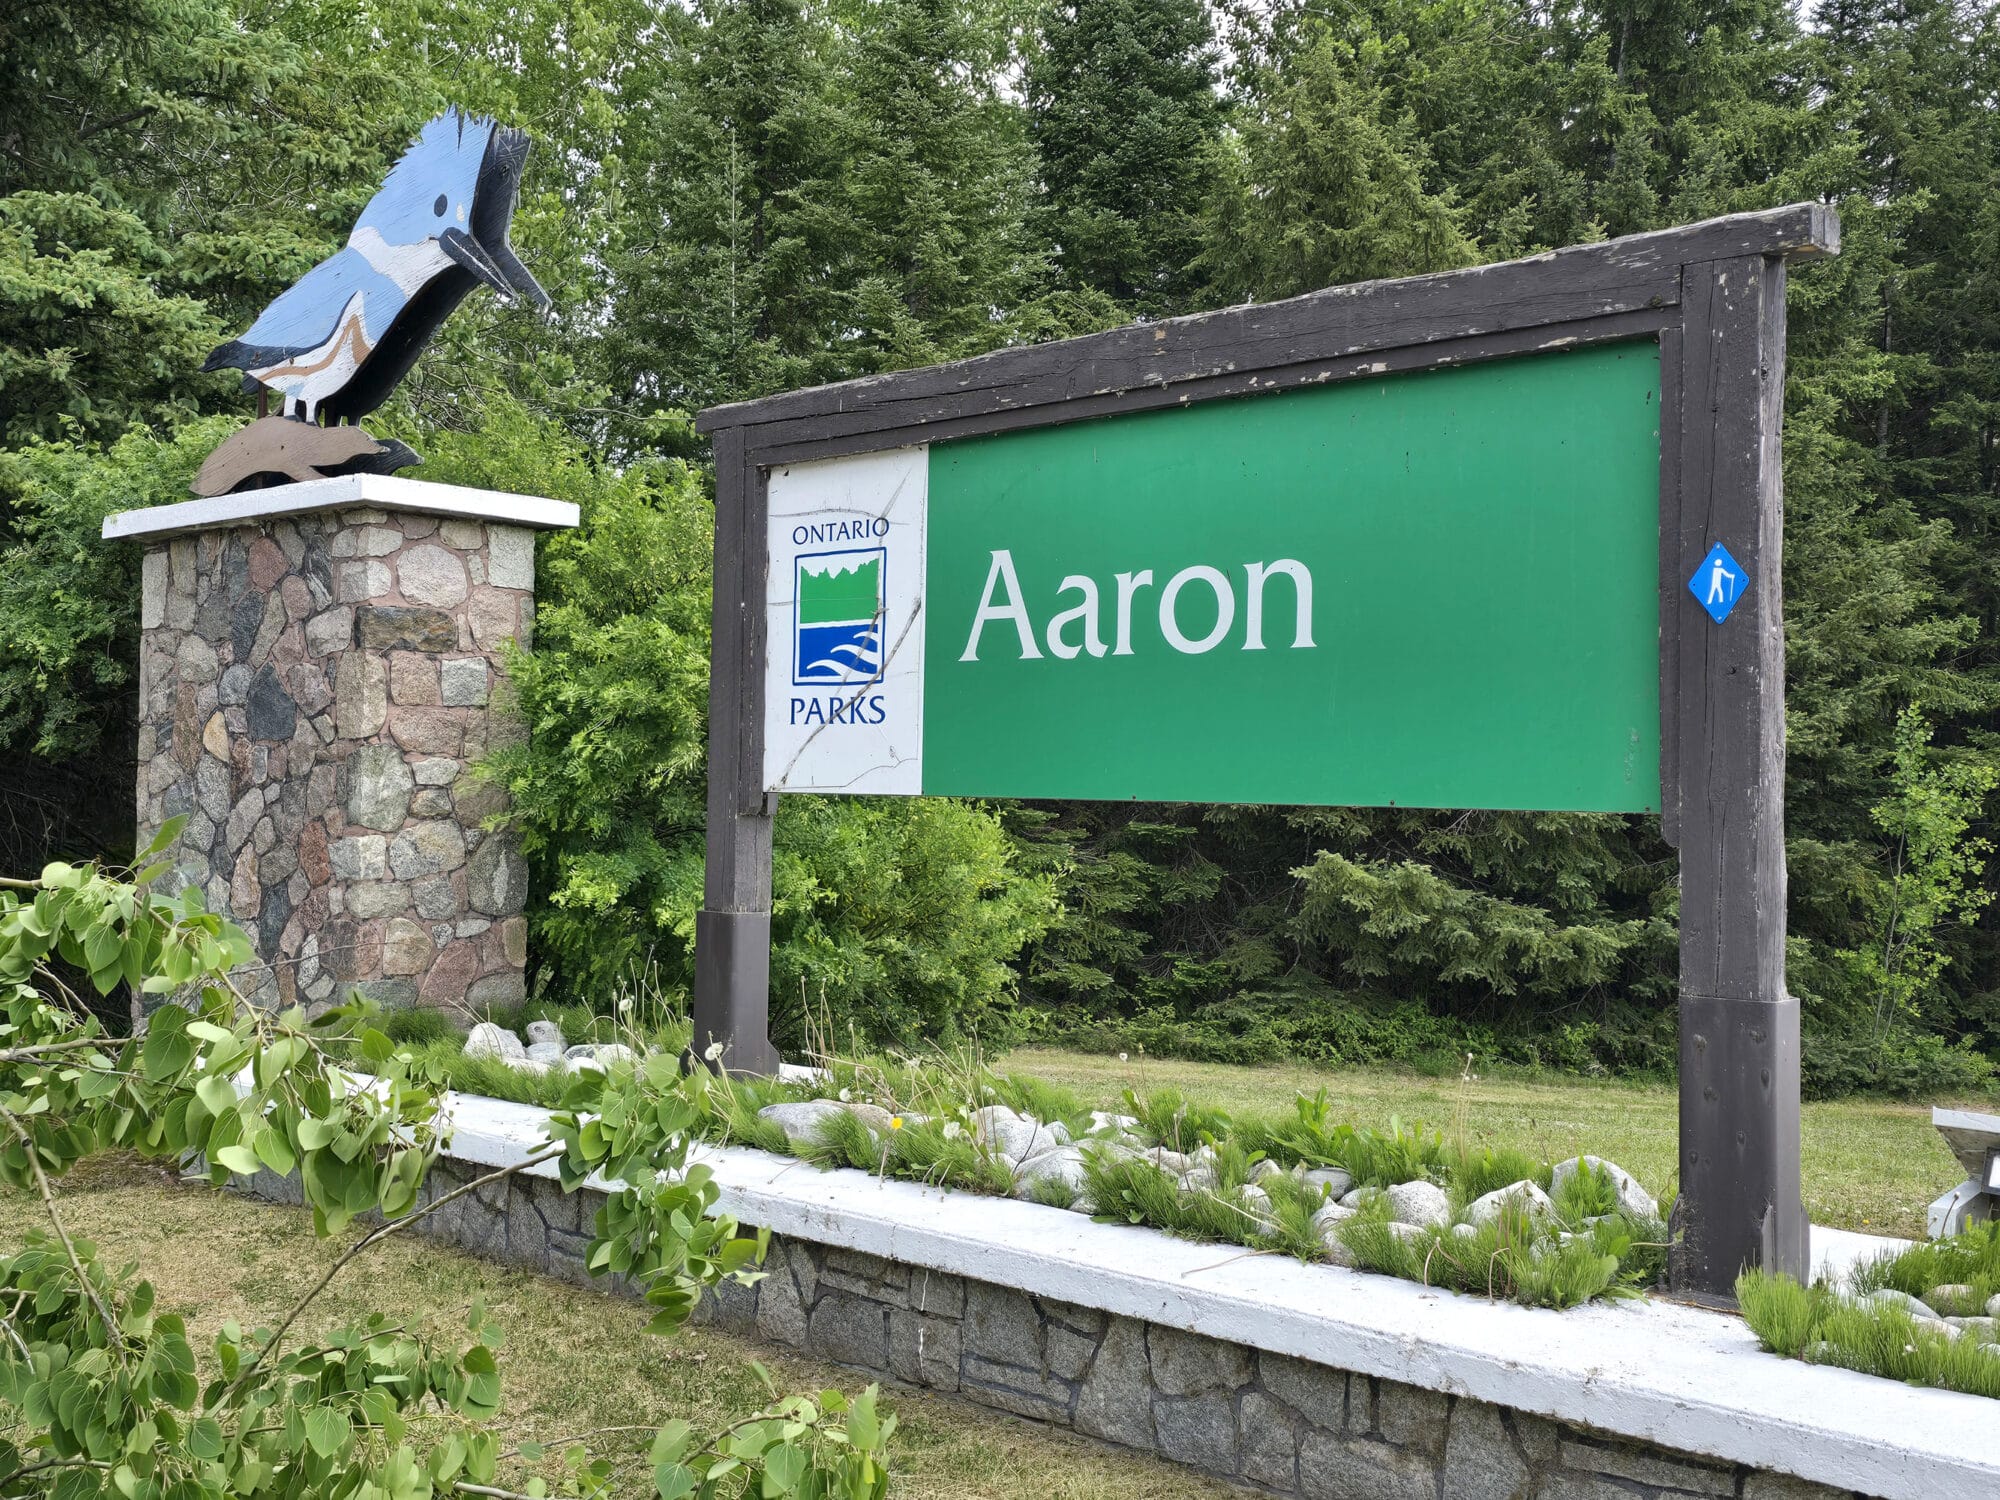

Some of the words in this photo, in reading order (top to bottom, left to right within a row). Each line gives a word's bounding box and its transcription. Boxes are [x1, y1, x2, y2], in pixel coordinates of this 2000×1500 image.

[792, 517, 890, 545] ONTARIO
[958, 549, 1318, 662] Aaron
[789, 694, 887, 726] PARKS
